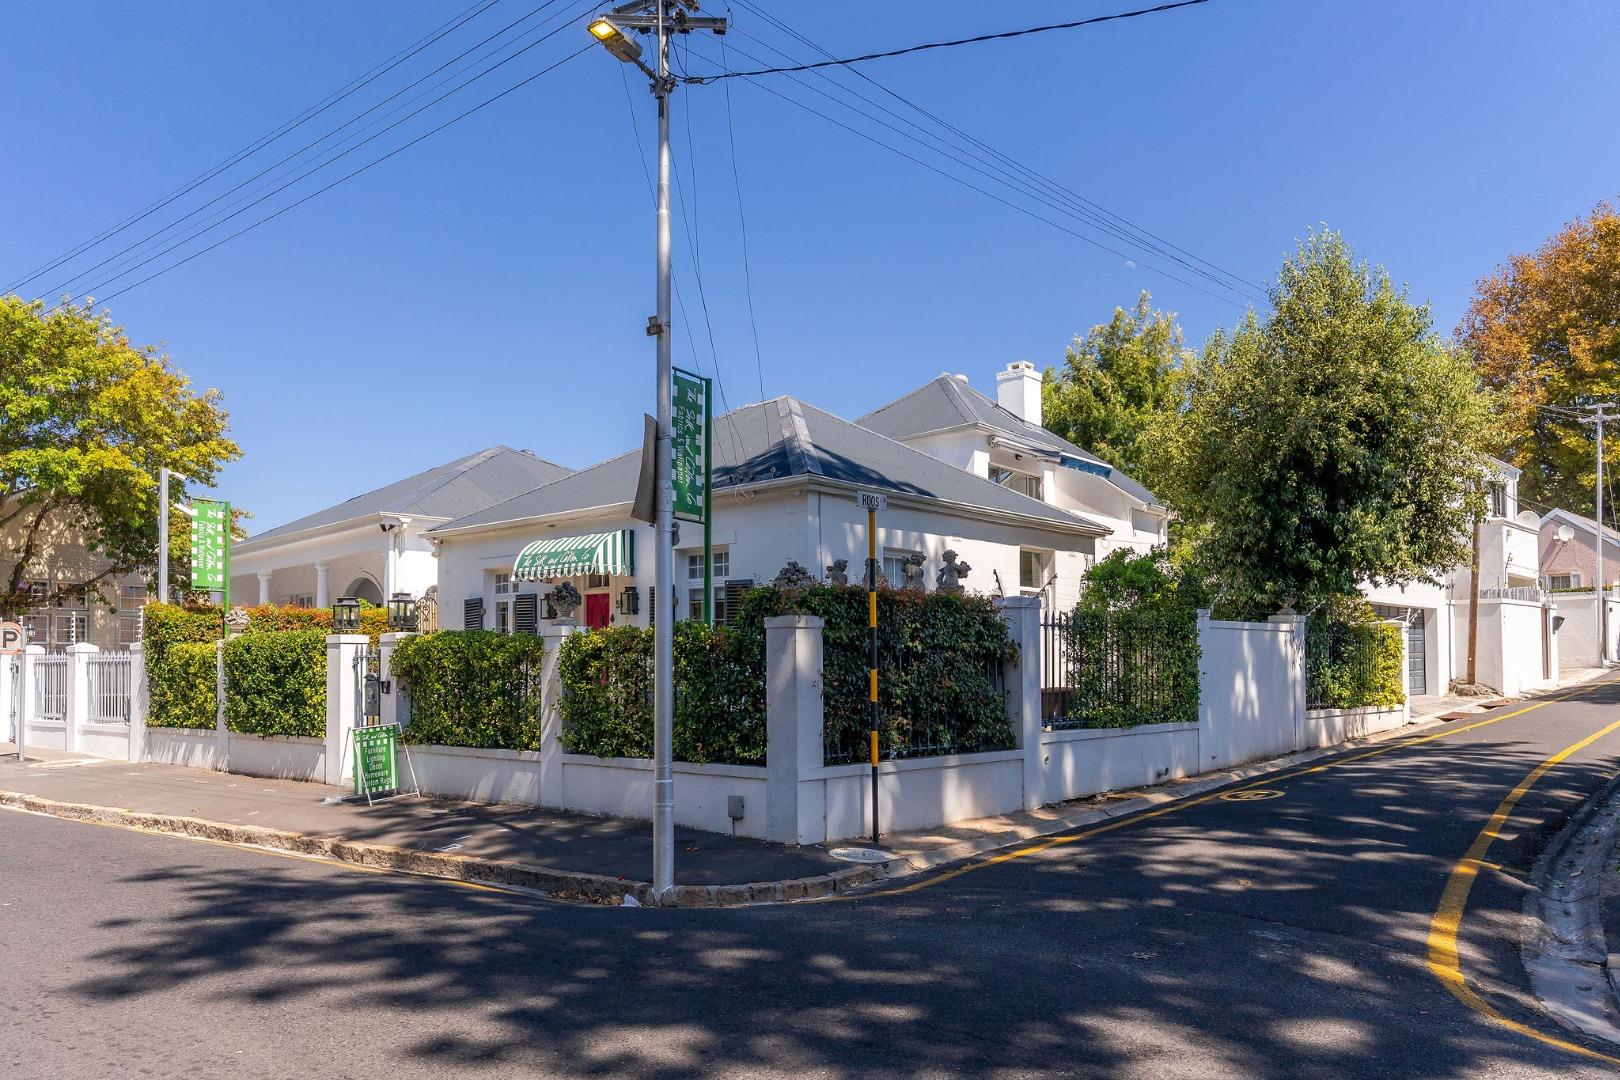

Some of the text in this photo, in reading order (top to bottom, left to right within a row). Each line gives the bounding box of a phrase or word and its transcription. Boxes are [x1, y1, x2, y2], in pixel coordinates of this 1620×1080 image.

[687, 388, 697, 404] The
[677, 405, 685, 434] Fabrics
[684, 408, 695, 432] Silk
[685, 434, 693, 456] and
[676, 445, 685, 484] Wallpaper
[685, 456, 696, 488] Cotton
[862, 494, 880, 508] ROOS
[522, 555, 532, 567] The
[534, 554, 547, 567] Silk
[547, 553, 562, 564] and
[560, 550, 578, 563] Cotton
[3, 630, 18, 648] P
[365, 746, 386, 755] Furniture
[366, 755, 386, 764] Lighting
